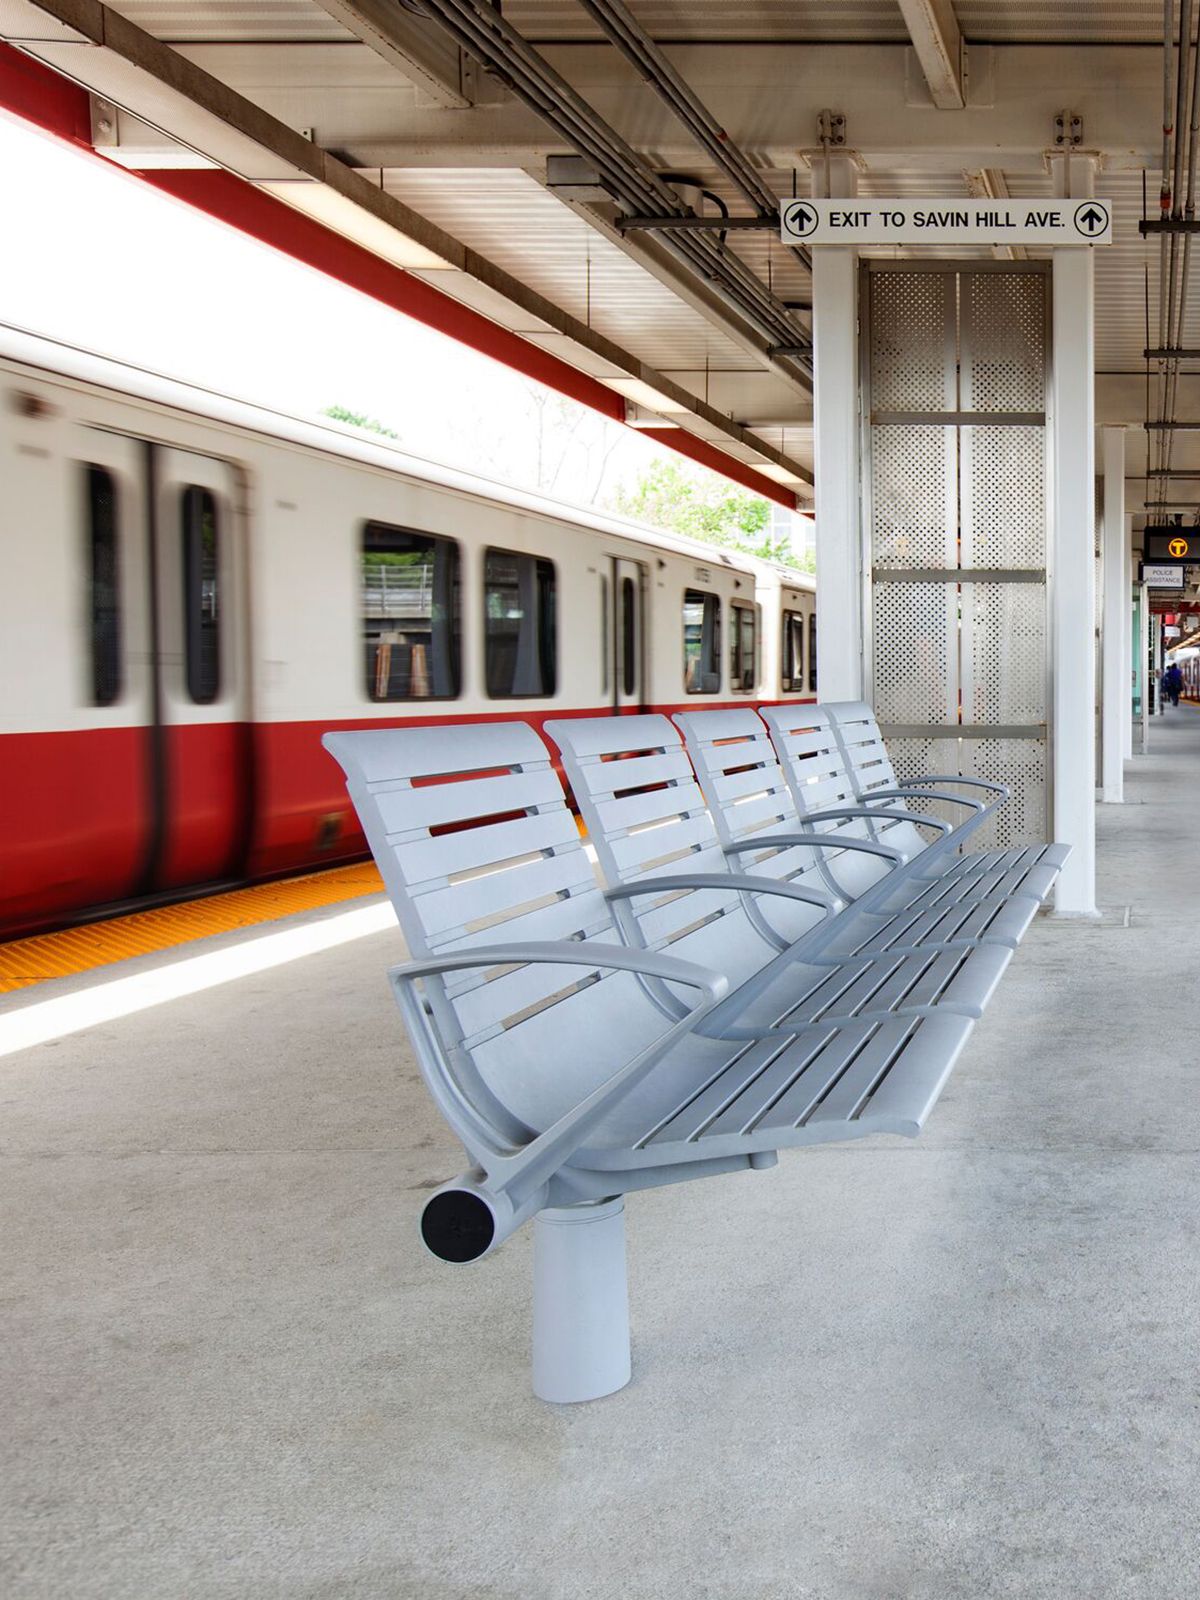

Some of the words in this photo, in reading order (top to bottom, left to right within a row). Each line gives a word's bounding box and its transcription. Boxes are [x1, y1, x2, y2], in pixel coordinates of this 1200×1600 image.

[829, 212, 871, 227] EXIT
[880, 212, 905, 227] TO
[913, 212, 968, 227] SAVIN
[976, 212, 1016, 227] HILL
[1024, 212, 1065, 227] AVE.
